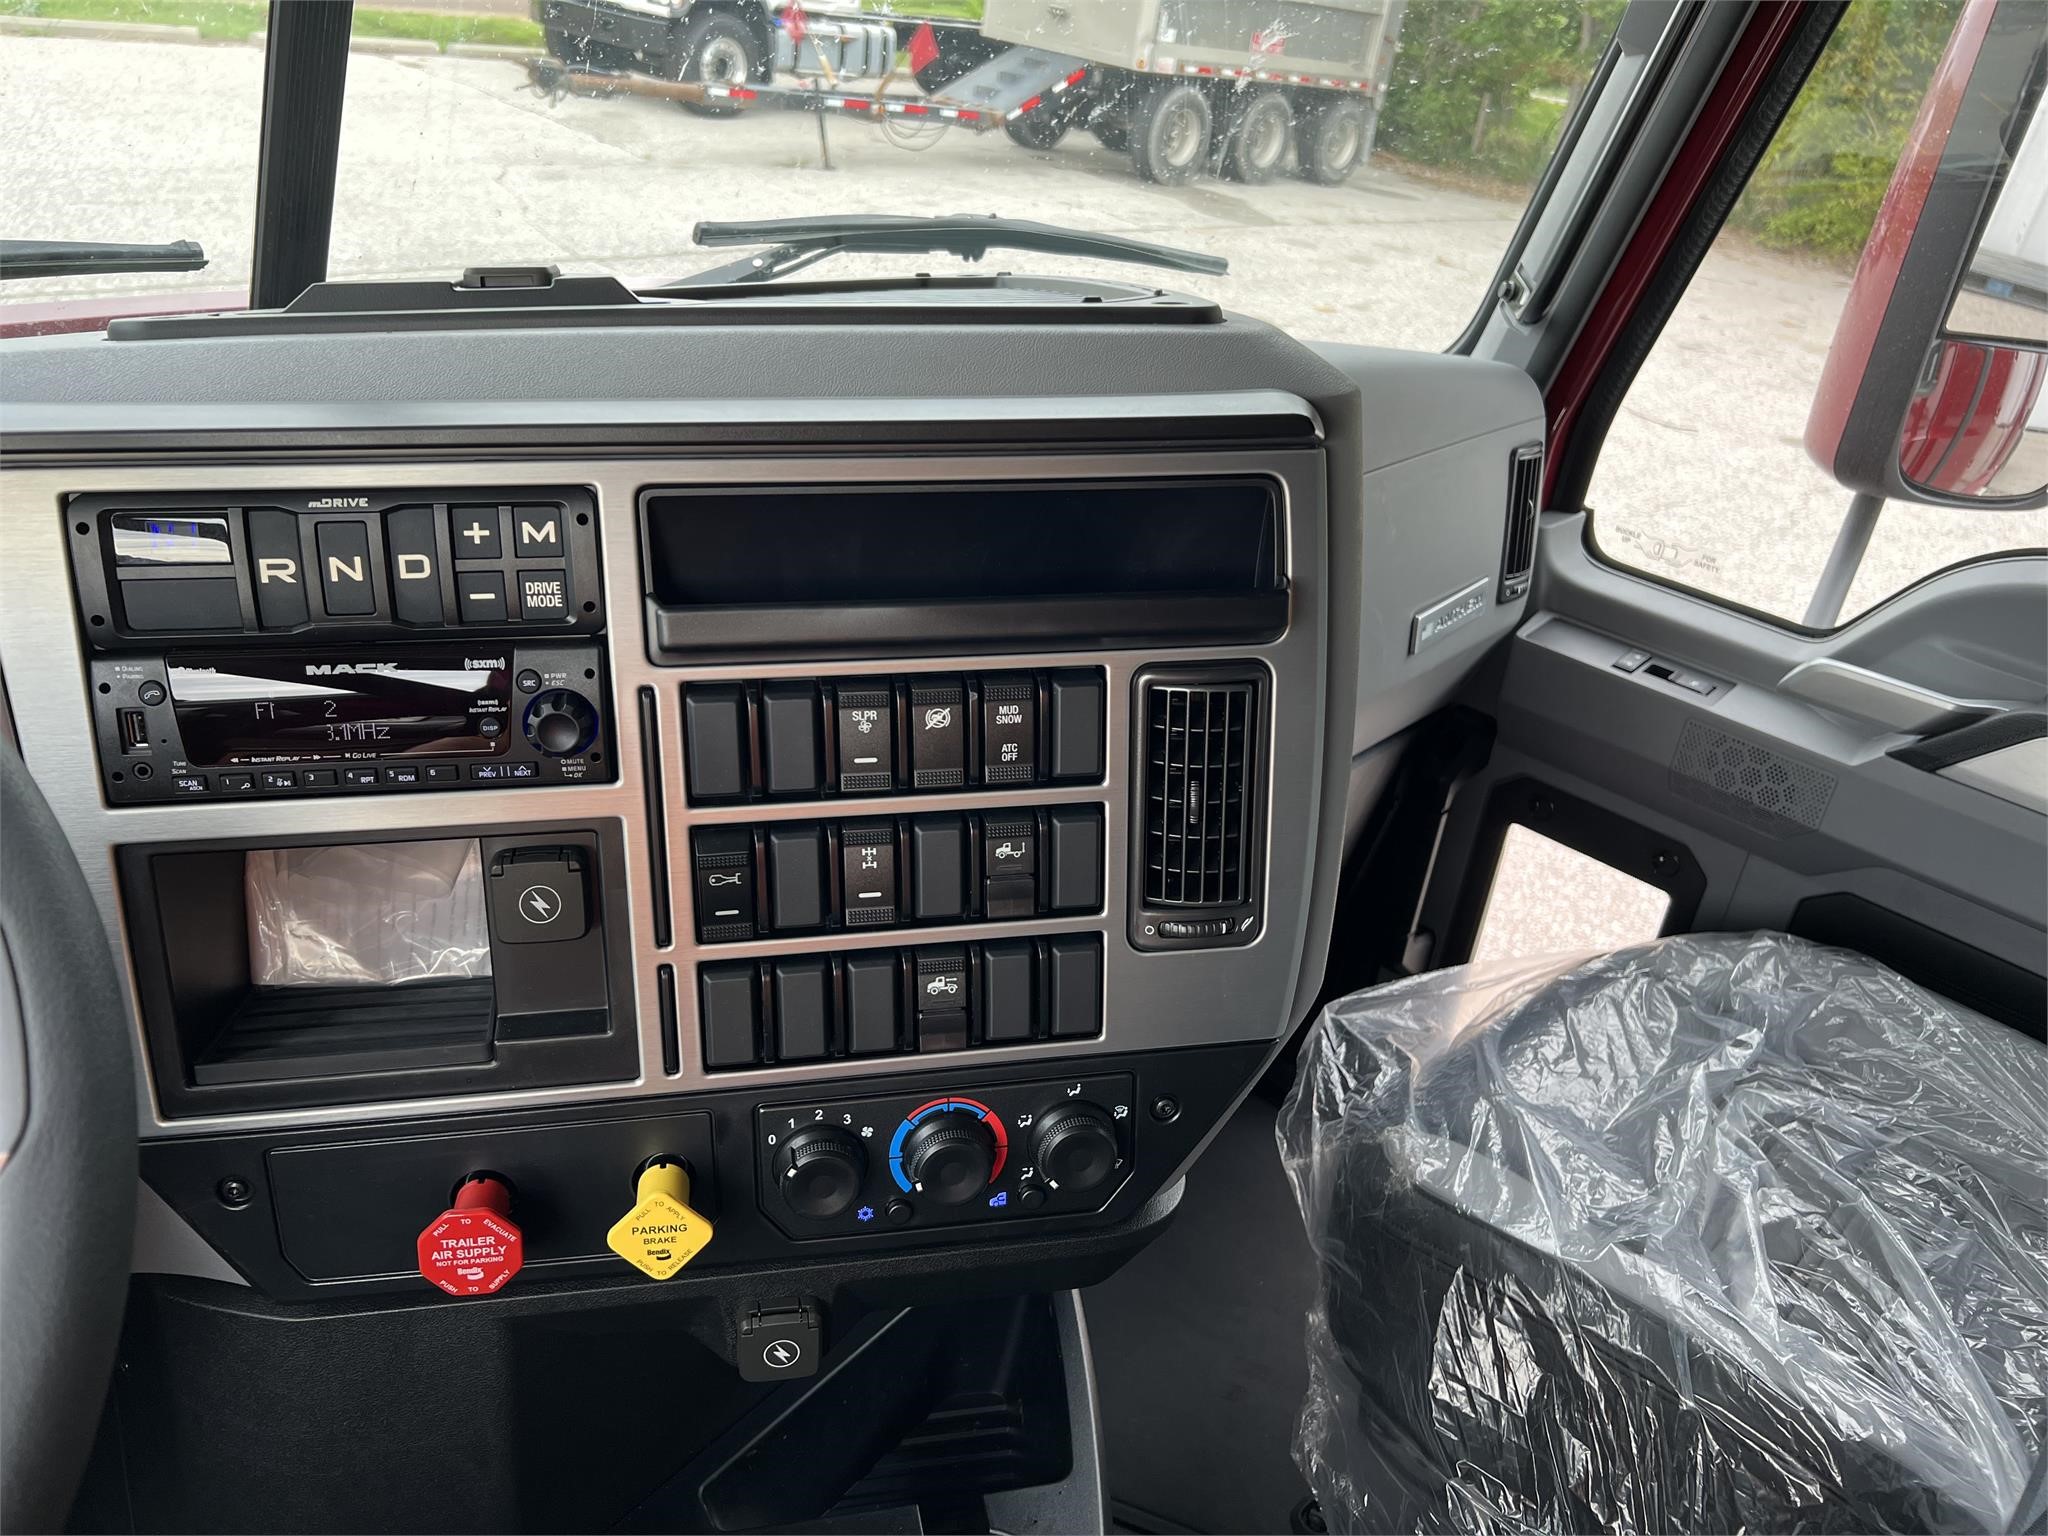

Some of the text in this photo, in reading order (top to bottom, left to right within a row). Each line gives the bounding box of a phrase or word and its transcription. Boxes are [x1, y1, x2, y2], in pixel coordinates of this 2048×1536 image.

[308, 497, 369, 508] mDRIVE
[521, 521, 556, 544] M
[258, 558, 297, 584] R
[328, 556, 364, 582] N
[398, 554, 431, 579] D
[525, 582, 561, 594] DRIVE
[526, 595, 563, 608] MODE
[305, 663, 398, 676] MACK
[852, 710, 878, 721] SLPR
[999, 705, 1019, 715] MUD
[996, 715, 1022, 725] SNOW
[1001, 743, 1018, 753] ATC
[1001, 752, 1018, 762] OFF
[514, 769, 532, 777] NEXT
[179, 780, 198, 788] SCAN
[360, 776, 374, 784] RPT
[814, 1109, 824, 1121] 2
[843, 1113, 852, 1125] 3
[788, 1117, 795, 1129] 1
[767, 1134, 777, 1145] 0
[666, 1206, 687, 1221] APPLY
[433, 1223, 449, 1237] PULL
[483, 1219, 518, 1242] EVACUATE
[631, 1223, 688, 1236] PARKING
[440, 1236, 496, 1249] TRAILER
[643, 1236, 677, 1245] BRAKE
[431, 1245, 507, 1260] AIR SUPPLY
[453, 1258, 470, 1266] FOR
[470, 1256, 504, 1264] PARKING
[636, 1260, 654, 1272] PUSH
[668, 1248, 693, 1270] RELEASE
[440, 1280, 458, 1293] PUSH
[489, 1269, 510, 1290] SUPPLY
